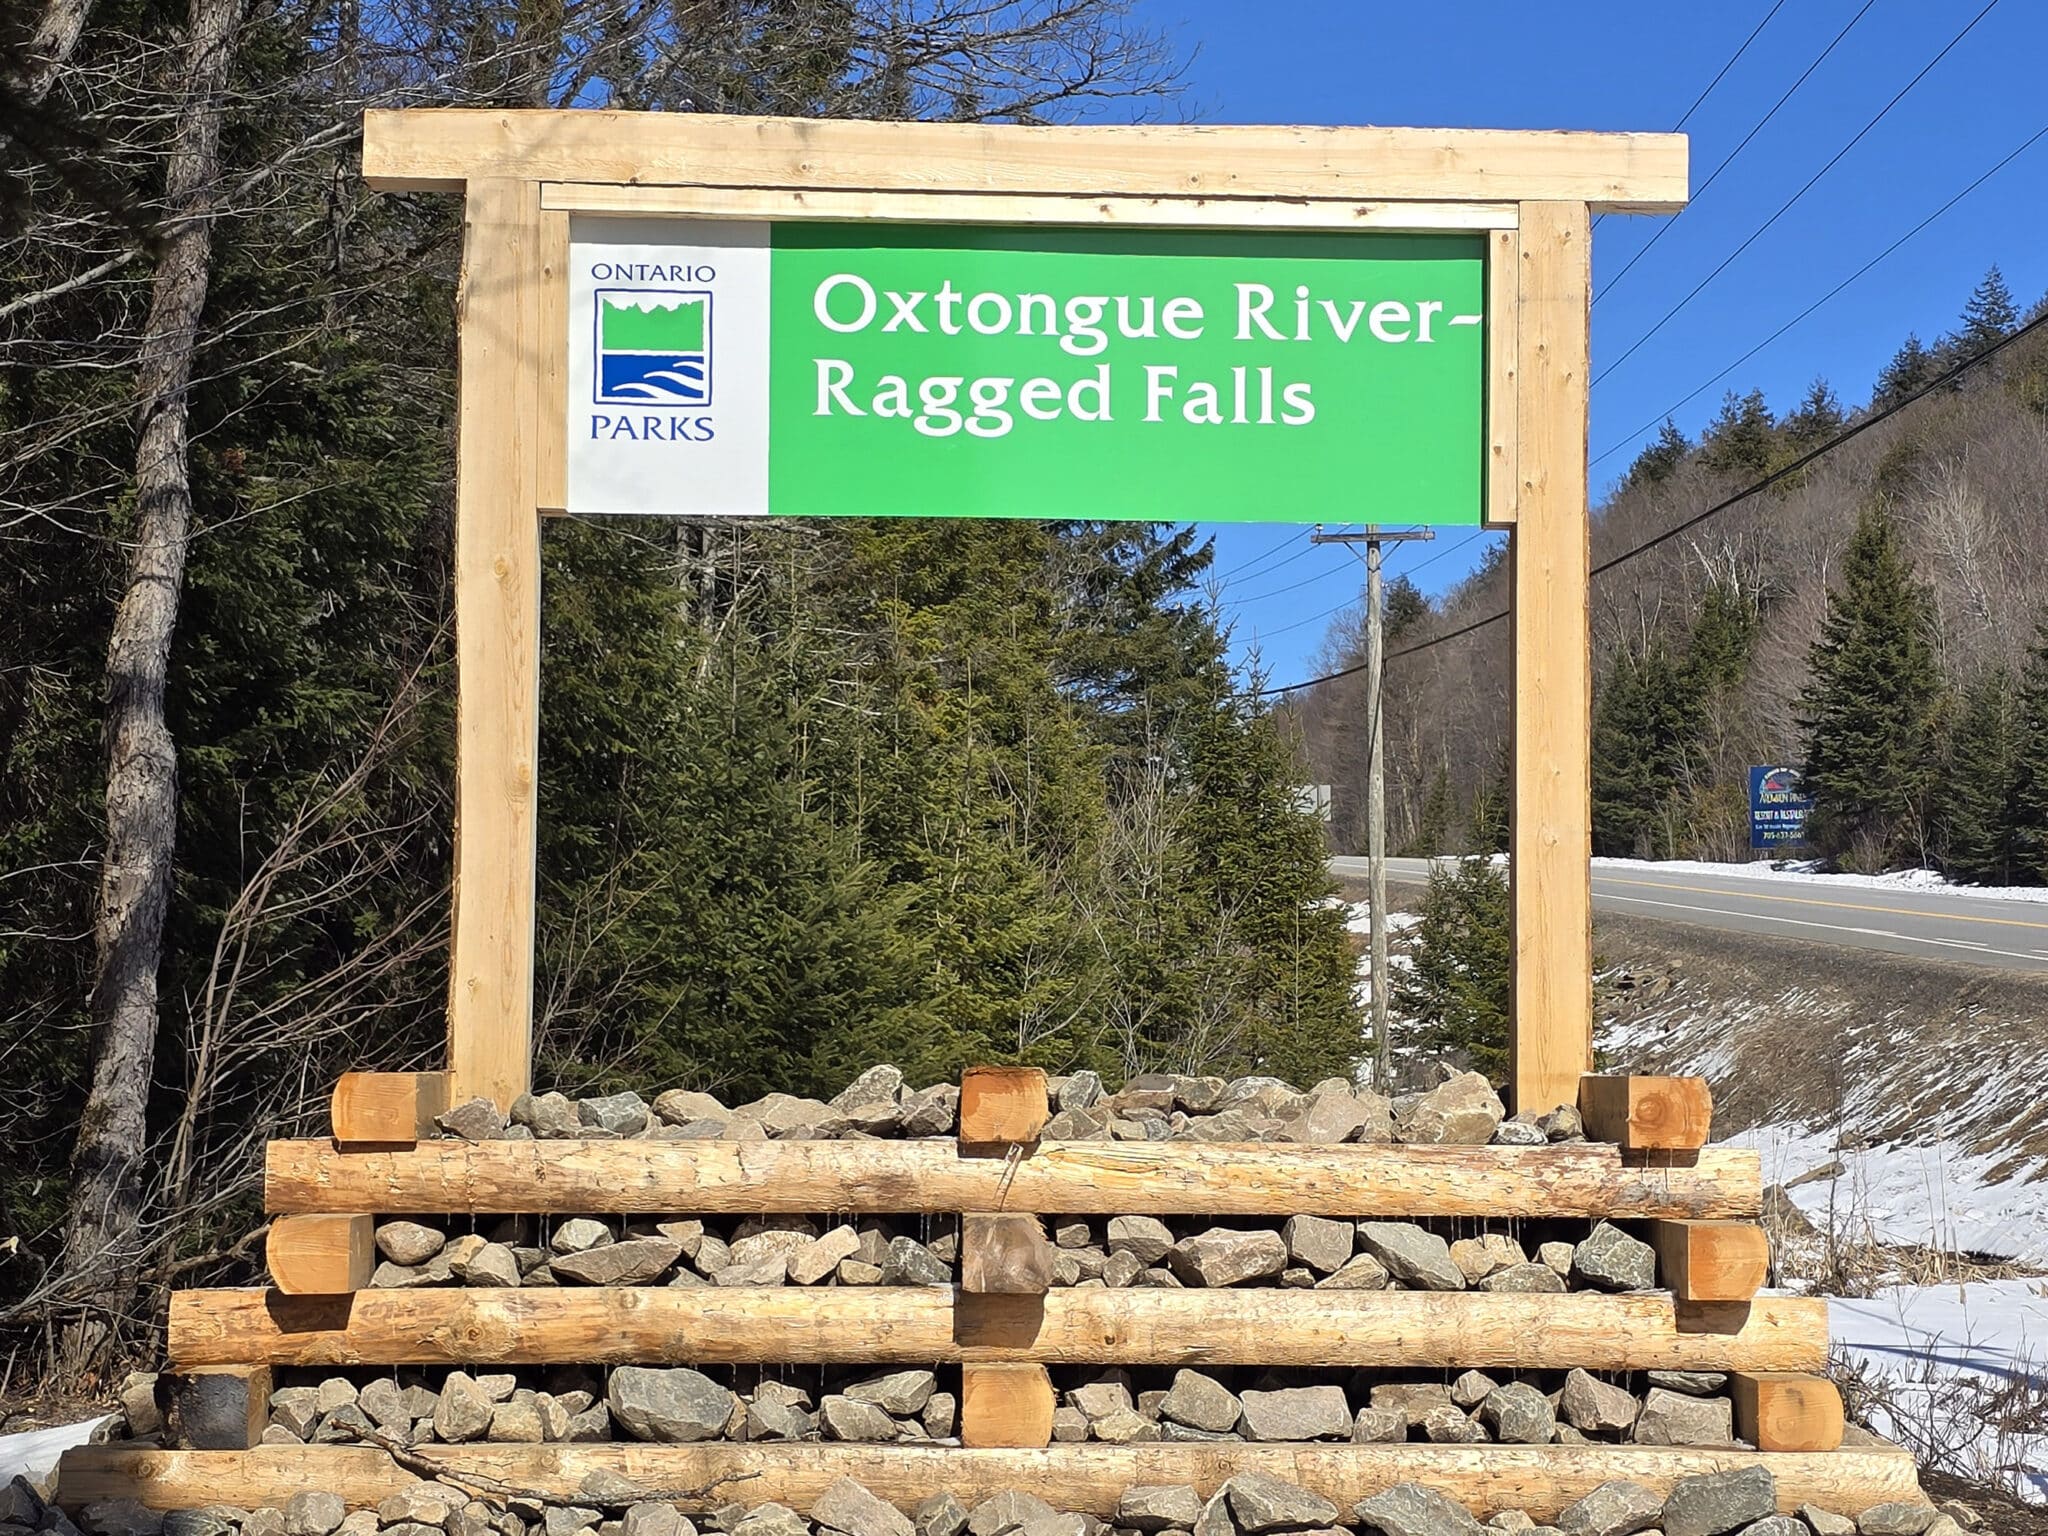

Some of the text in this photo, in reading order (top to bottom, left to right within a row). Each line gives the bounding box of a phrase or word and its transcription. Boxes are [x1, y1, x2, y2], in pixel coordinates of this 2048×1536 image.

[591, 263, 716, 282] ONTARIO
[813, 273, 1205, 357] Oxtongue
[812, 358, 1316, 438] Ragged Falls
[591, 415, 715, 441] PARKS
